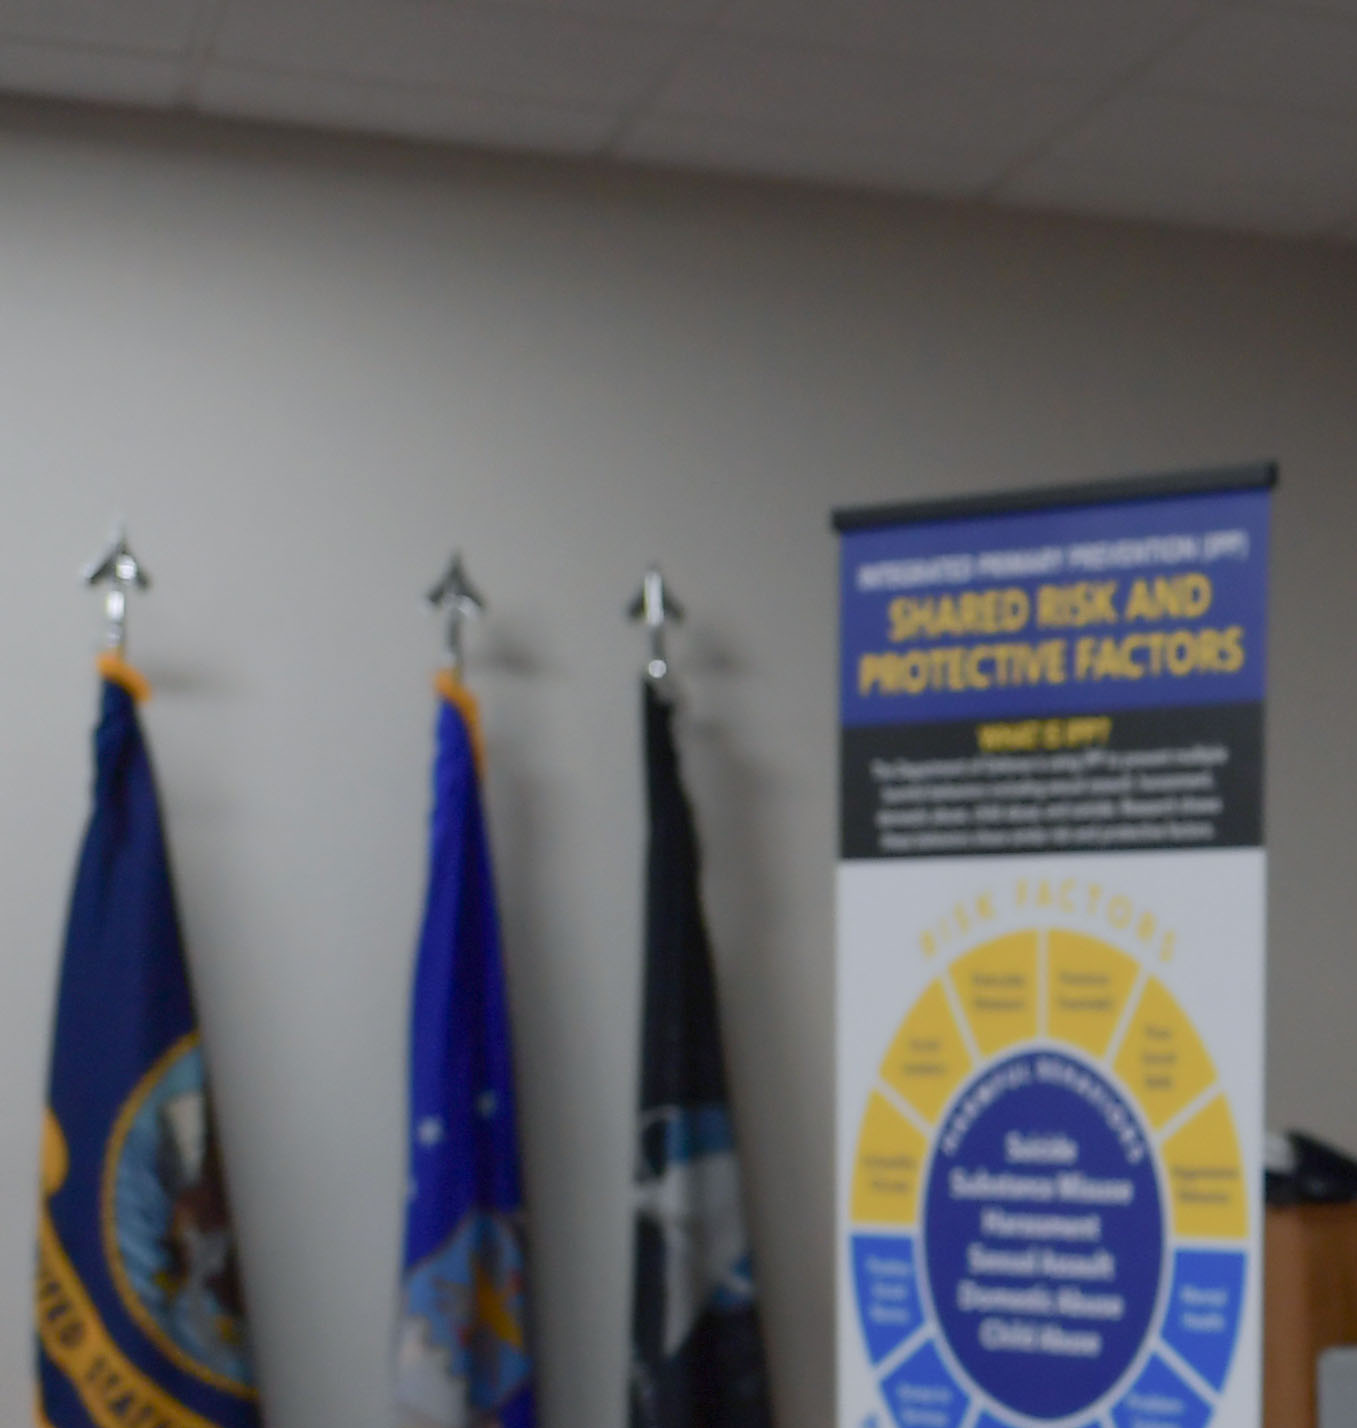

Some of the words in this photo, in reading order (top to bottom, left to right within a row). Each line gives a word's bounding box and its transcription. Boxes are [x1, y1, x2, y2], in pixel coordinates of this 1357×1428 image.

[887, 587, 1030, 643] SHARED
[1036, 580, 1118, 630] RISK
[1124, 572, 1213, 622] AND
[859, 638, 1067, 697] PROTECTIVE
[1074, 625, 1245, 682] FACTORS
